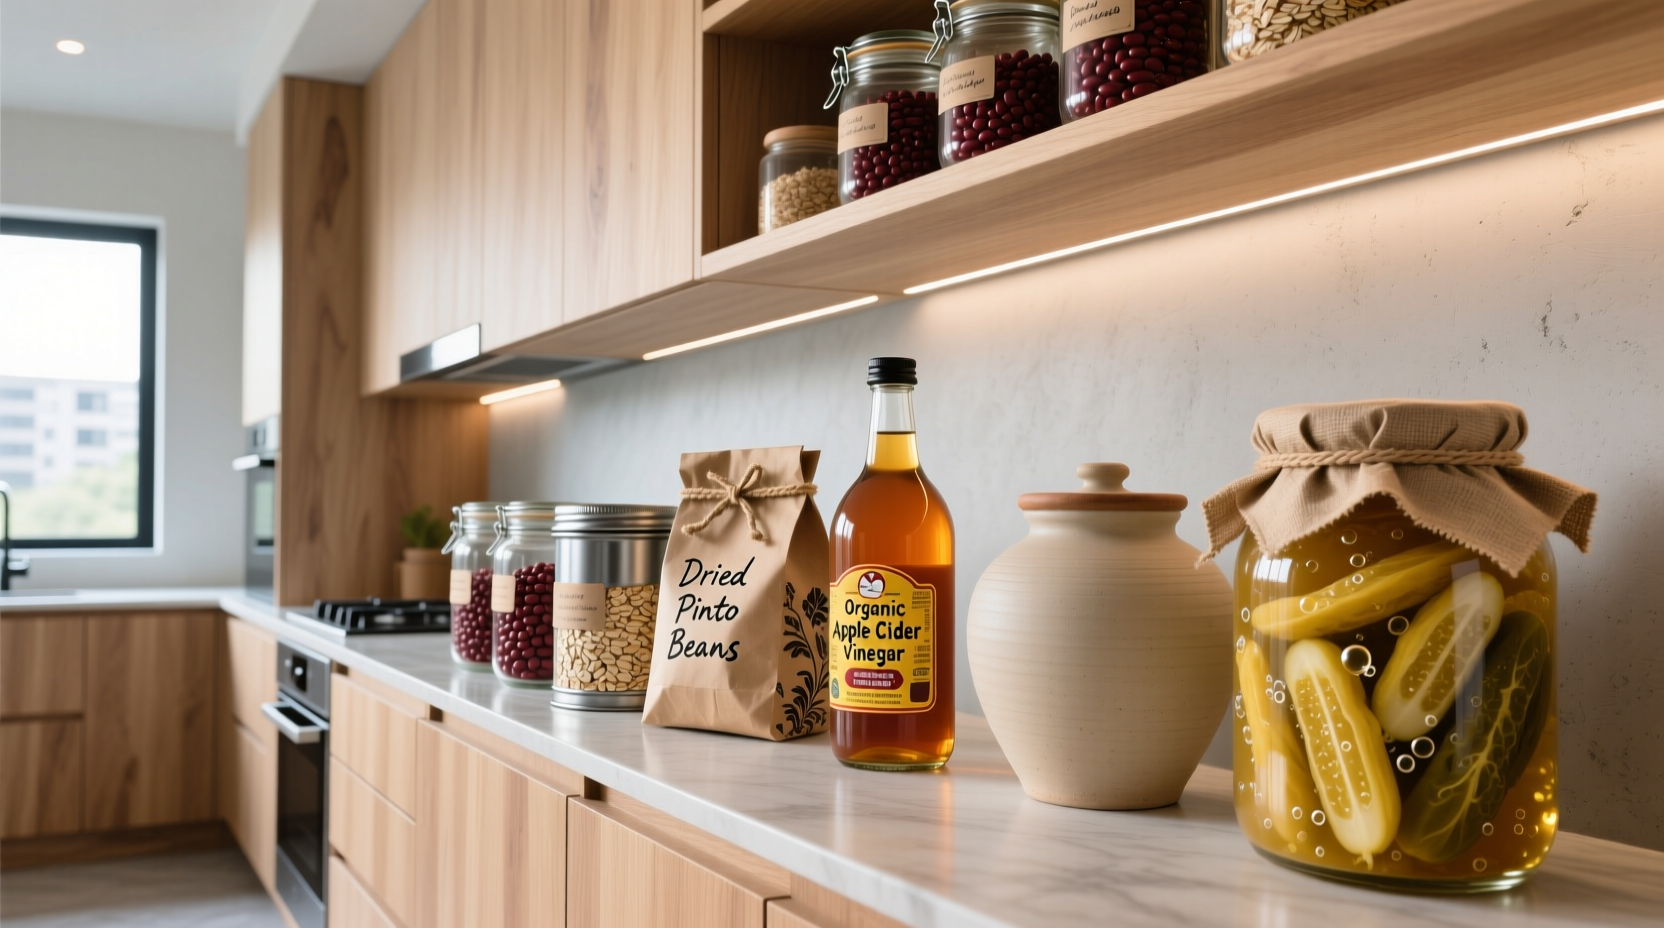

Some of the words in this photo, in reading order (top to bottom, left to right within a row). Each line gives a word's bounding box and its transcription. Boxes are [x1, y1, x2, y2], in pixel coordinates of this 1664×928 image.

[678, 556, 756, 588] Dried
[675, 593, 739, 624] Pinto
[844, 598, 906, 621] Organic
[667, 627, 740, 662] Beans
[832, 620, 871, 644] Apple
[875, 620, 922, 640] Cider
[843, 643, 905, 667] Vinegar
